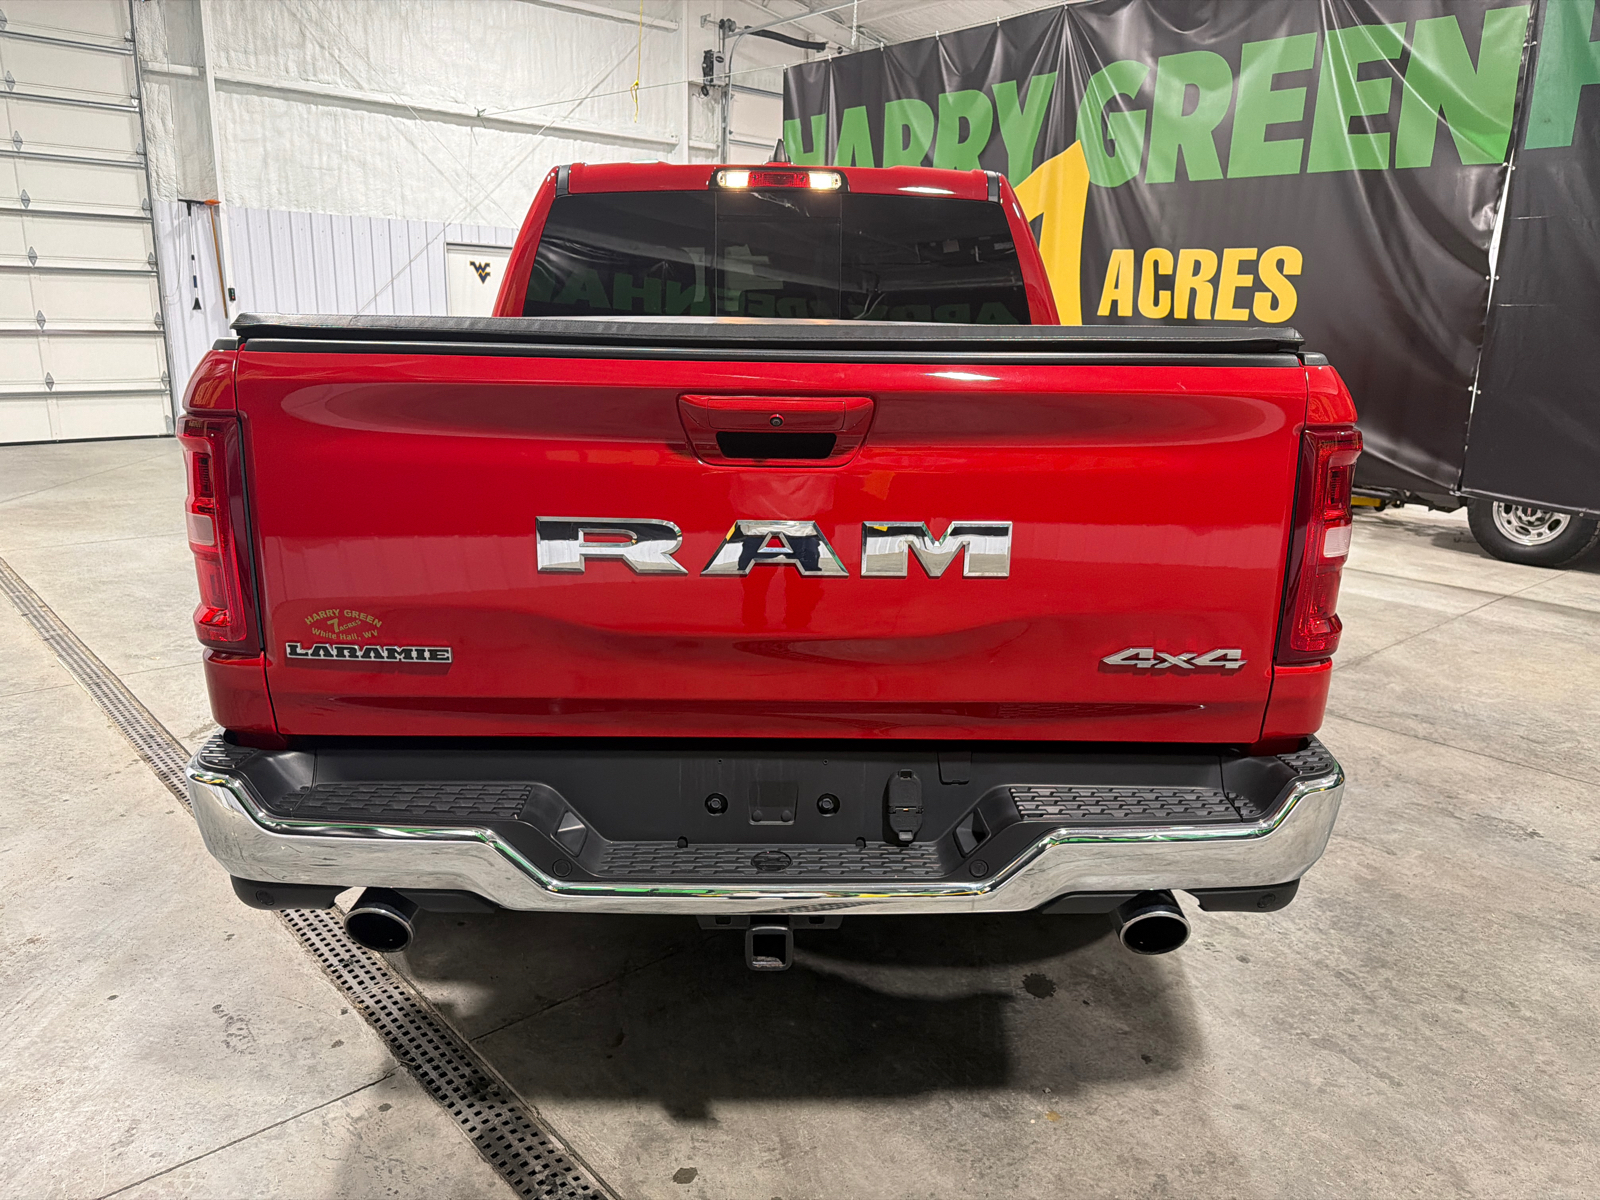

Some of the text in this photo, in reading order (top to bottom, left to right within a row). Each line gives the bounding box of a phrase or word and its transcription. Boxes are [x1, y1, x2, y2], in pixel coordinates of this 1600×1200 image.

[783, 71, 1058, 189] HARRY
[1076, 5, 1530, 187] GREEN
[1097, 246, 1303, 323] ACRES
[535, 515, 1013, 578] RAM
[304, 609, 382, 628] HARRY GREEN
[327, 618, 361, 633] 7 ACRES
[312, 627, 378, 641] White Hall, WV
[285, 642, 452, 663] LARAMIE
[1101, 647, 1248, 669] 4x4
